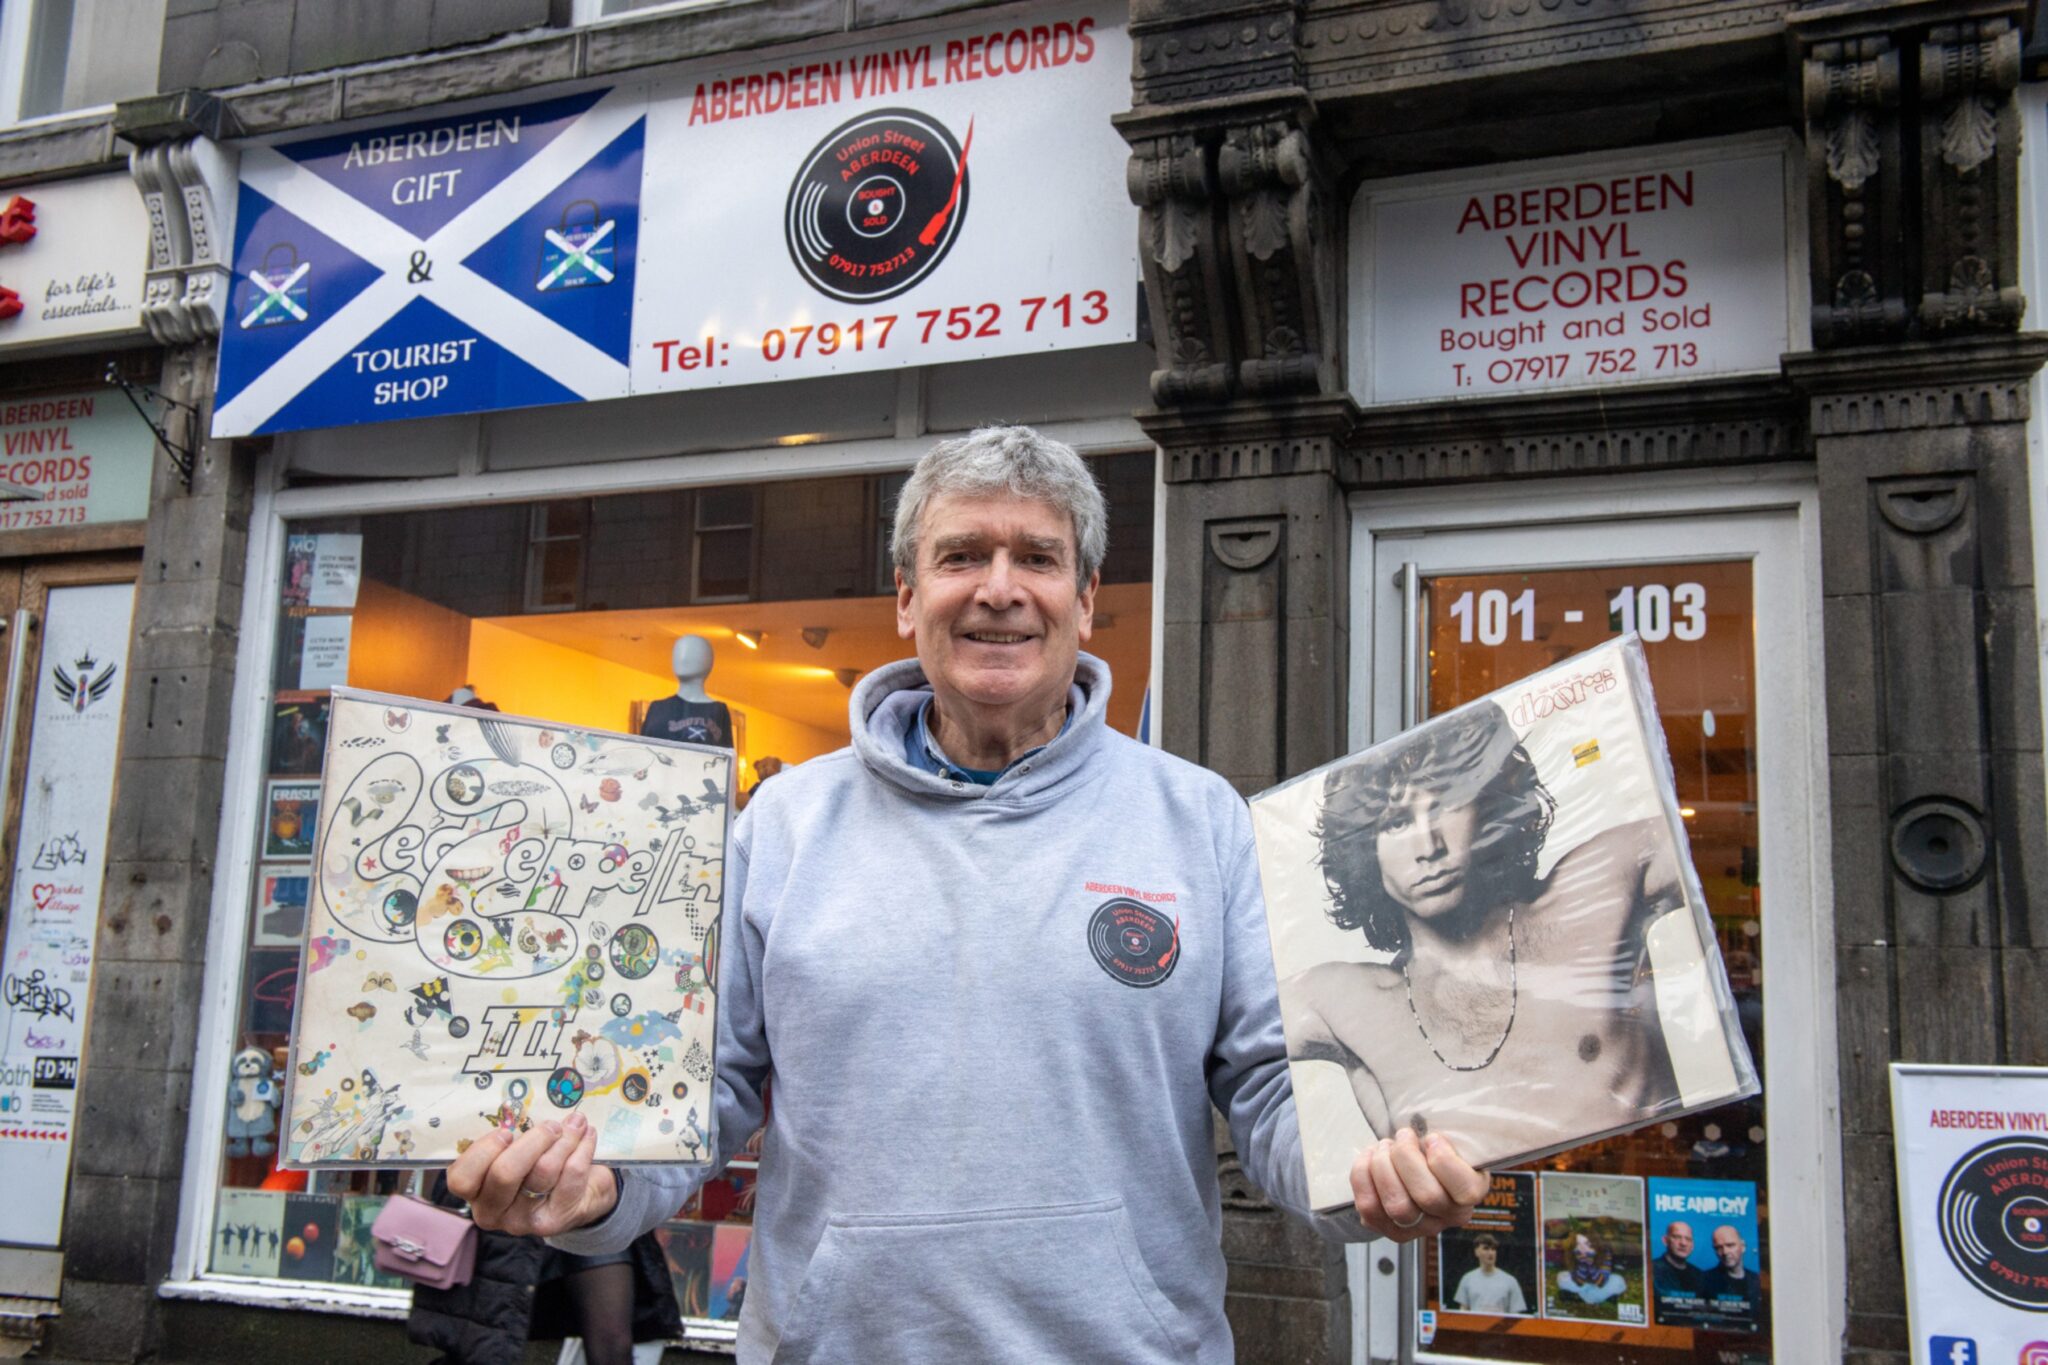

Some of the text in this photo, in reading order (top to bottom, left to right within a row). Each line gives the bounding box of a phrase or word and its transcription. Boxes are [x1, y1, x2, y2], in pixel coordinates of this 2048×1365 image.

[688, 17, 1096, 127] ABERDEEN VINYL RECORDS
[343, 116, 521, 170] ABERDEEN
[836, 130, 926, 162] Union Street
[840, 149, 920, 182] ABERDEEN
[391, 169, 462, 205] GIFT
[858, 187, 896, 199] BOUGHT
[1456, 171, 1694, 234] ABERDEEN
[863, 216, 887, 227] SOLD
[1506, 222, 1641, 268] VINYL
[407, 250, 434, 284] &
[829, 247, 916, 277] 07917 752713
[46, 280, 72, 303] for
[75, 272, 117, 297] life's
[1460, 260, 1689, 319] RECORDS
[652, 290, 1109, 373] Tel: 07917 752 713
[1440, 304, 1711, 352] Bought and Sold
[352, 338, 478, 374] TOURIST
[1452, 342, 1698, 387] T: 07917 752 713
[373, 375, 449, 404] SHOP
[4, 426, 73, 457] VINYL
[59, 483, 89, 500] sold
[0, 506, 86, 528] 17 752 713
[1450, 588, 1535, 646] 101
[1610, 582, 1707, 643] 103
[1084, 881, 1177, 903] ABERDEEN VINYL RECORDS
[462, 1005, 580, 1074] III
[1929, 1109, 2005, 1131] ABERDEEN
[1983, 1156, 2029, 1177] Union
[1654, 1193, 1686, 1213] HUE
[1686, 1196, 1718, 1214] AND
[1718, 1196, 1749, 1216] CRY
[1989, 1260, 2030, 1286] 07917
